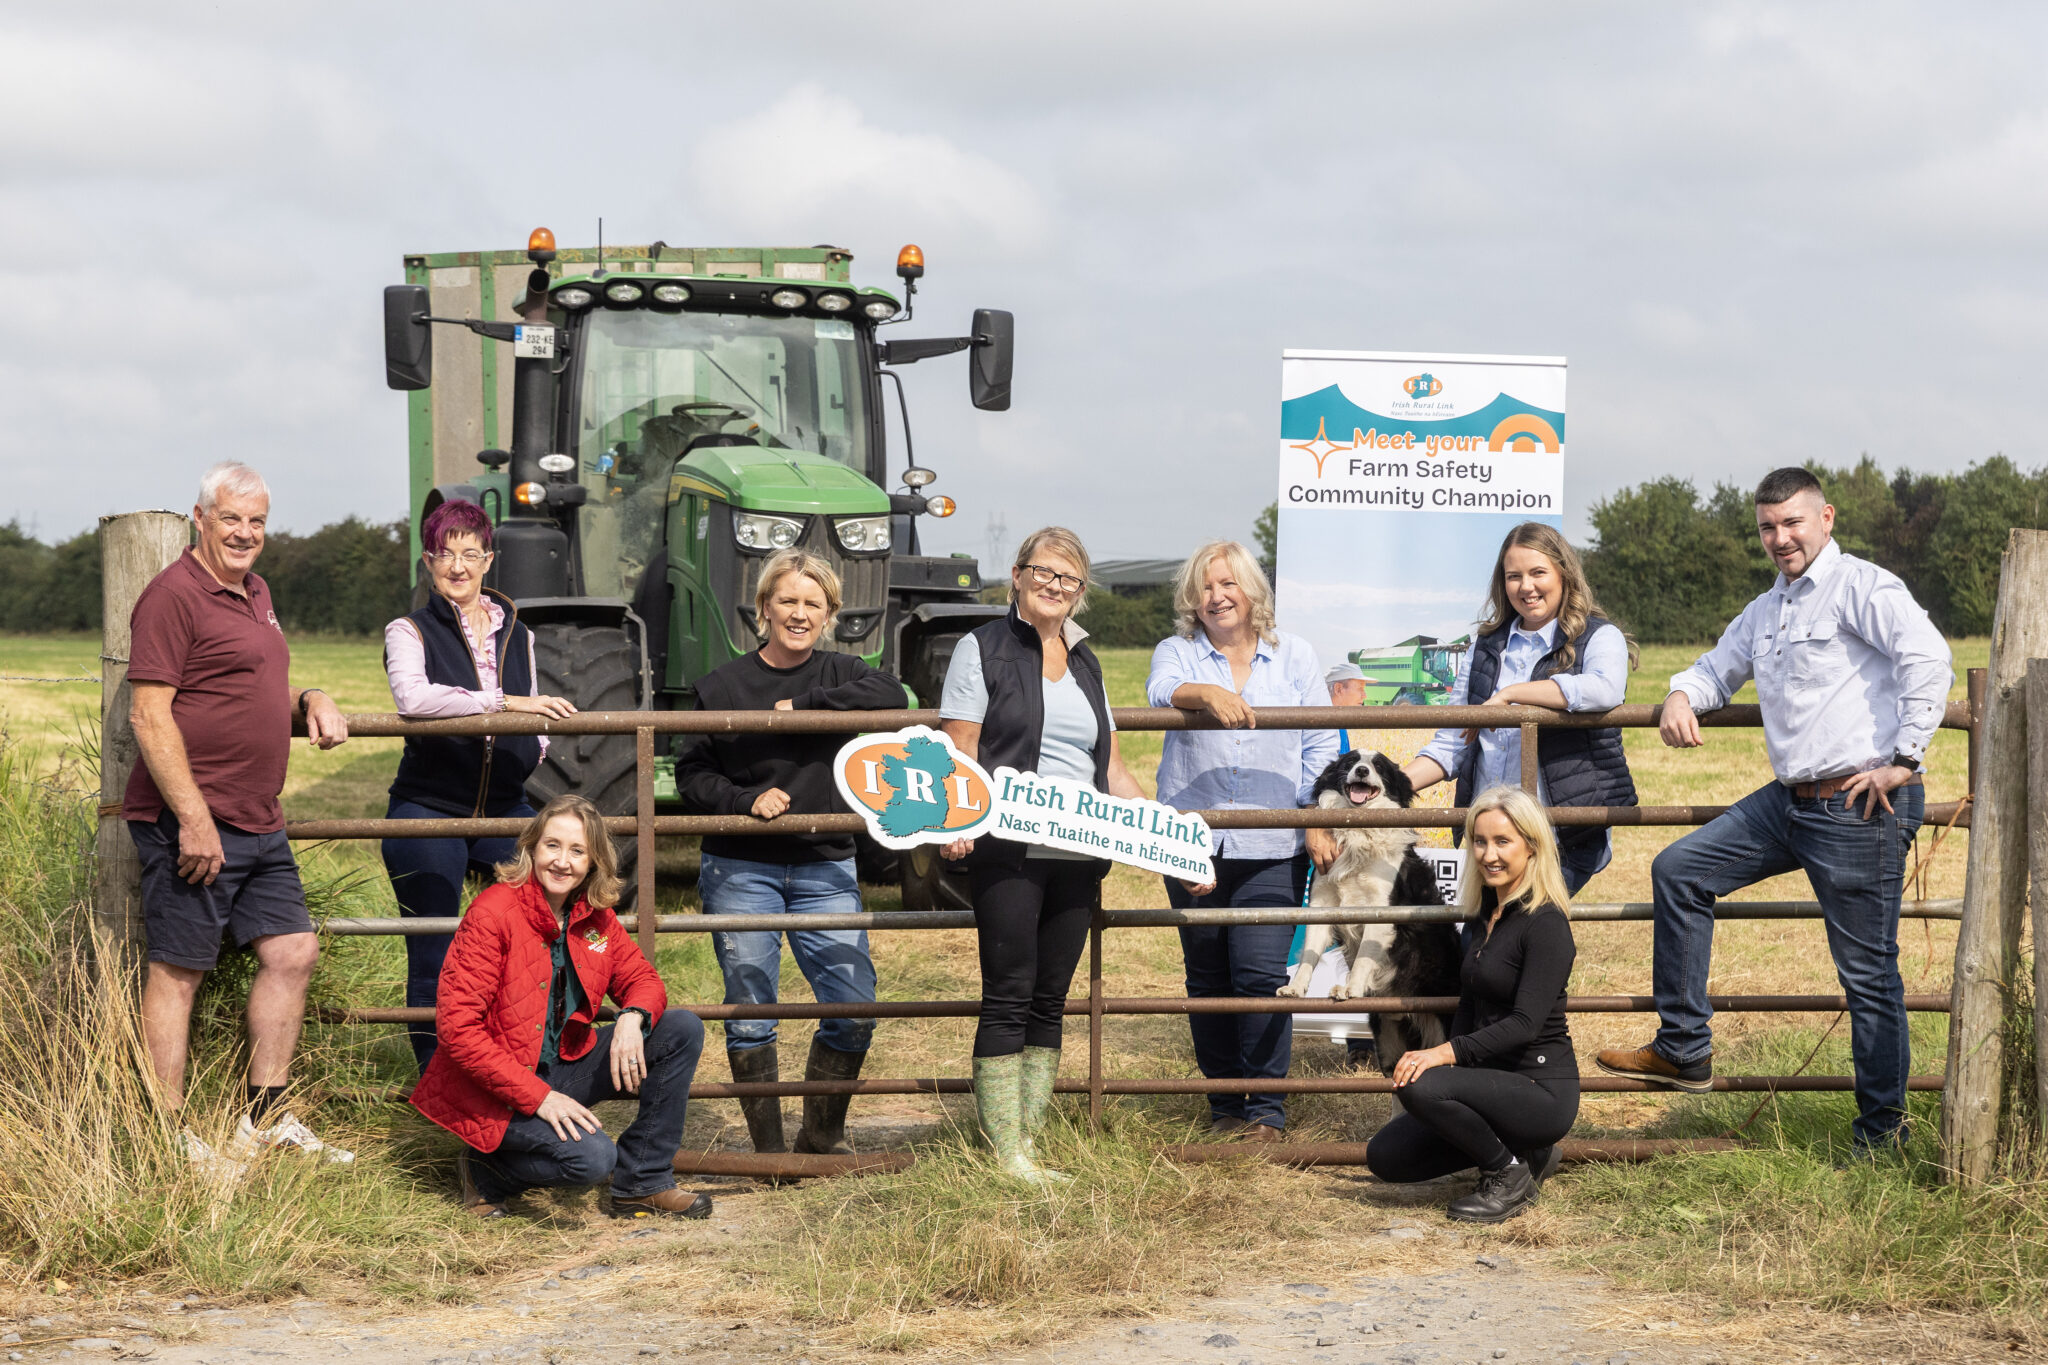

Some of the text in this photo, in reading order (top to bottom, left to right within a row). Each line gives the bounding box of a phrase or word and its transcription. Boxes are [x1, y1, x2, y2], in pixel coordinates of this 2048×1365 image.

[526, 334, 554, 345] 232-KE
[1407, 380, 1441, 391] IRL
[1413, 401, 1434, 409] Rural
[1353, 428, 1484, 457] Meet your
[1349, 459, 1492, 483] Farm Safety
[1288, 485, 1551, 511] Community Champion
[862, 760, 982, 811] IRL
[1000, 776, 1207, 848] Irish Rural Link
[998, 813, 1041, 834] Nasc
[1048, 821, 1110, 849] Tuaithe
[1114, 840, 1134, 855] na
